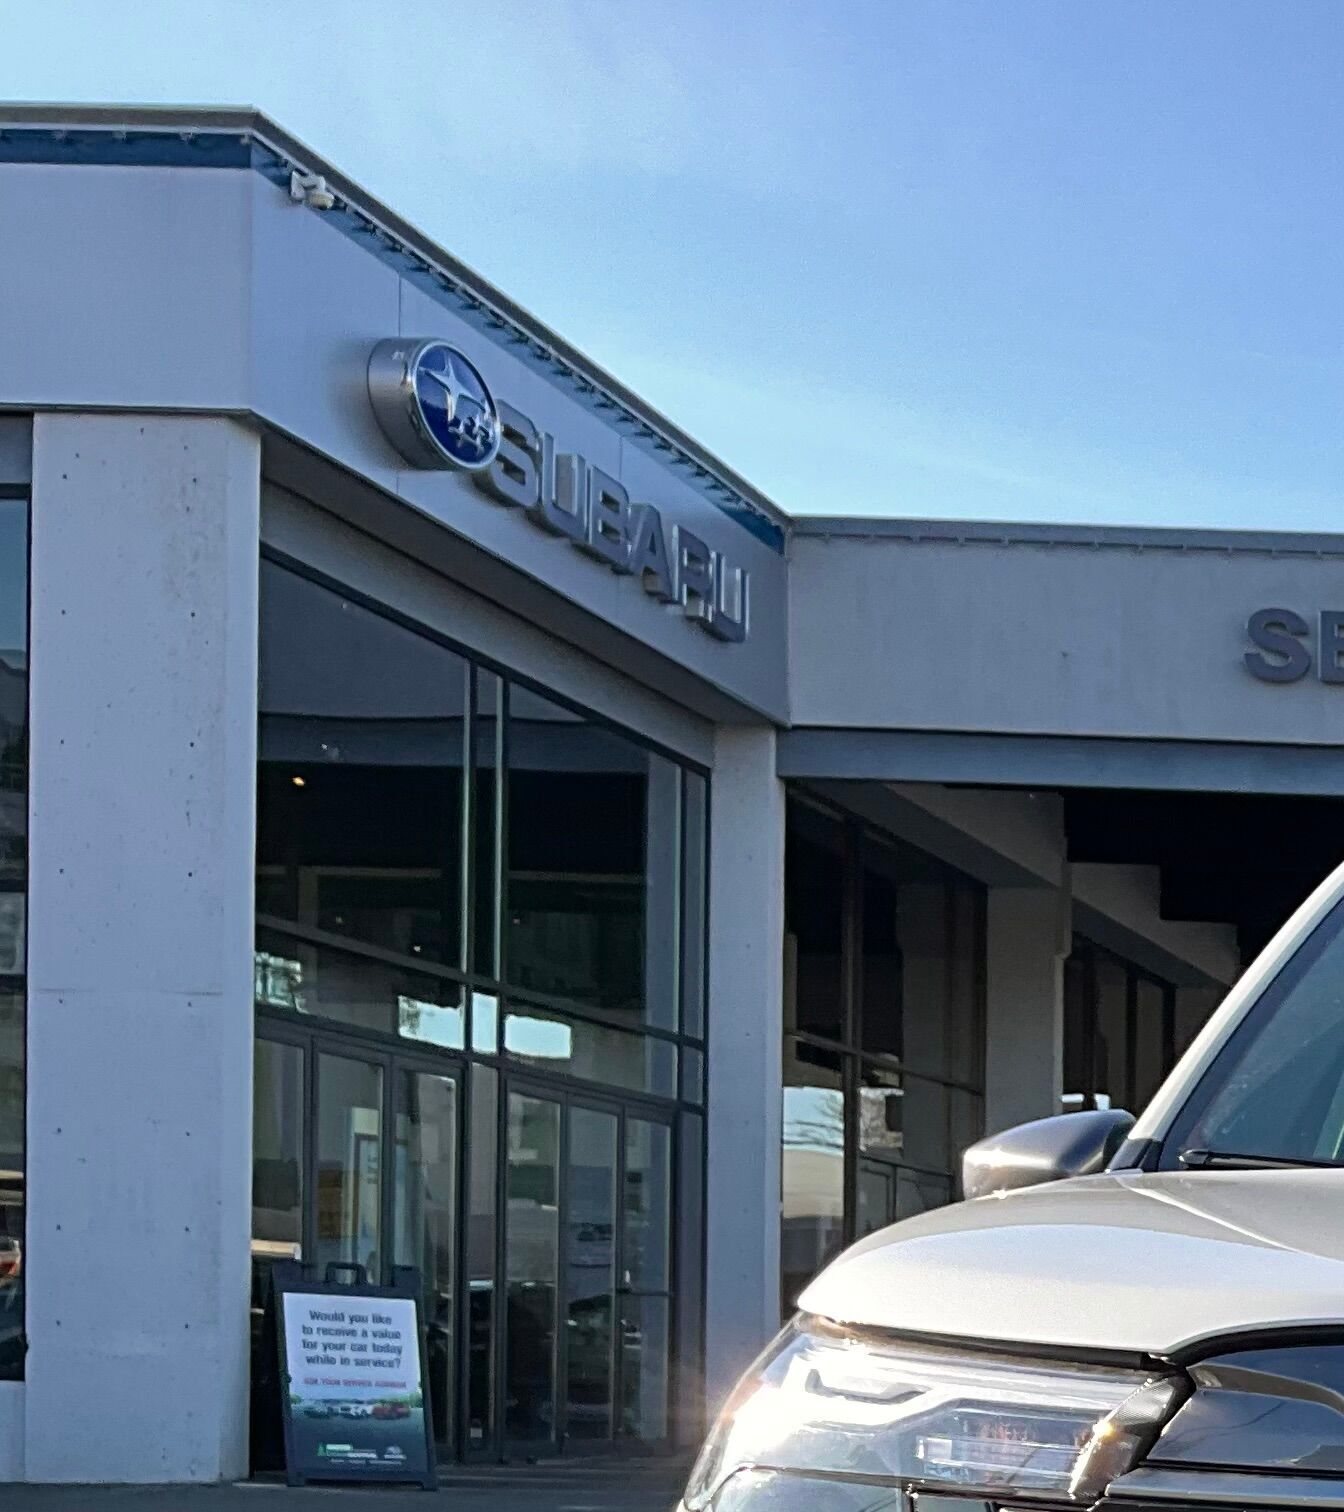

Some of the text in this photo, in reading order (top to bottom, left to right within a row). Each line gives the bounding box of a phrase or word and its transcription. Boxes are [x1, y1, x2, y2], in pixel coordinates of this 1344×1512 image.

[490, 399, 750, 643] SUBARU
[309, 1309, 392, 1325] Would you like
[302, 1324, 401, 1340] to receive a value
[302, 1339, 317, 1350] for
[321, 1341, 346, 1353] your
[350, 1343, 368, 1353] car
[306, 1354, 336, 1366] while
[340, 1355, 351, 1366] in
